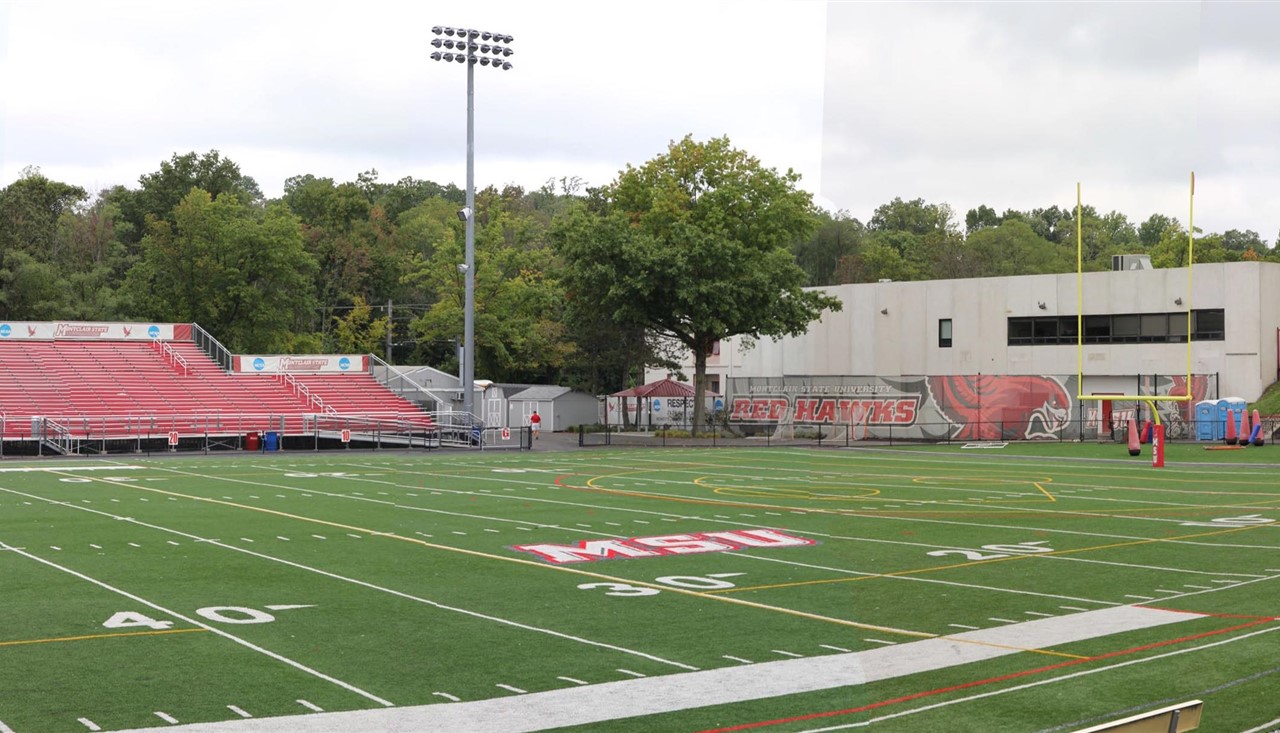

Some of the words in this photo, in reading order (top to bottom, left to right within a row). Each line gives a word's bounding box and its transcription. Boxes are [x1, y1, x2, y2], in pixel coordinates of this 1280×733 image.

[750, 385, 798, 393] MONTCLAIR
[800, 385, 830, 393] STATE
[834, 385, 892, 393] UNIVERSITY
[667, 399, 694, 408] RESPEC
[730, 397, 789, 421] RED
[793, 398, 916, 425] HAWKS
[169, 432, 178, 443] 20
[342, 430, 350, 441] 10
[512, 529, 816, 565] MSU
